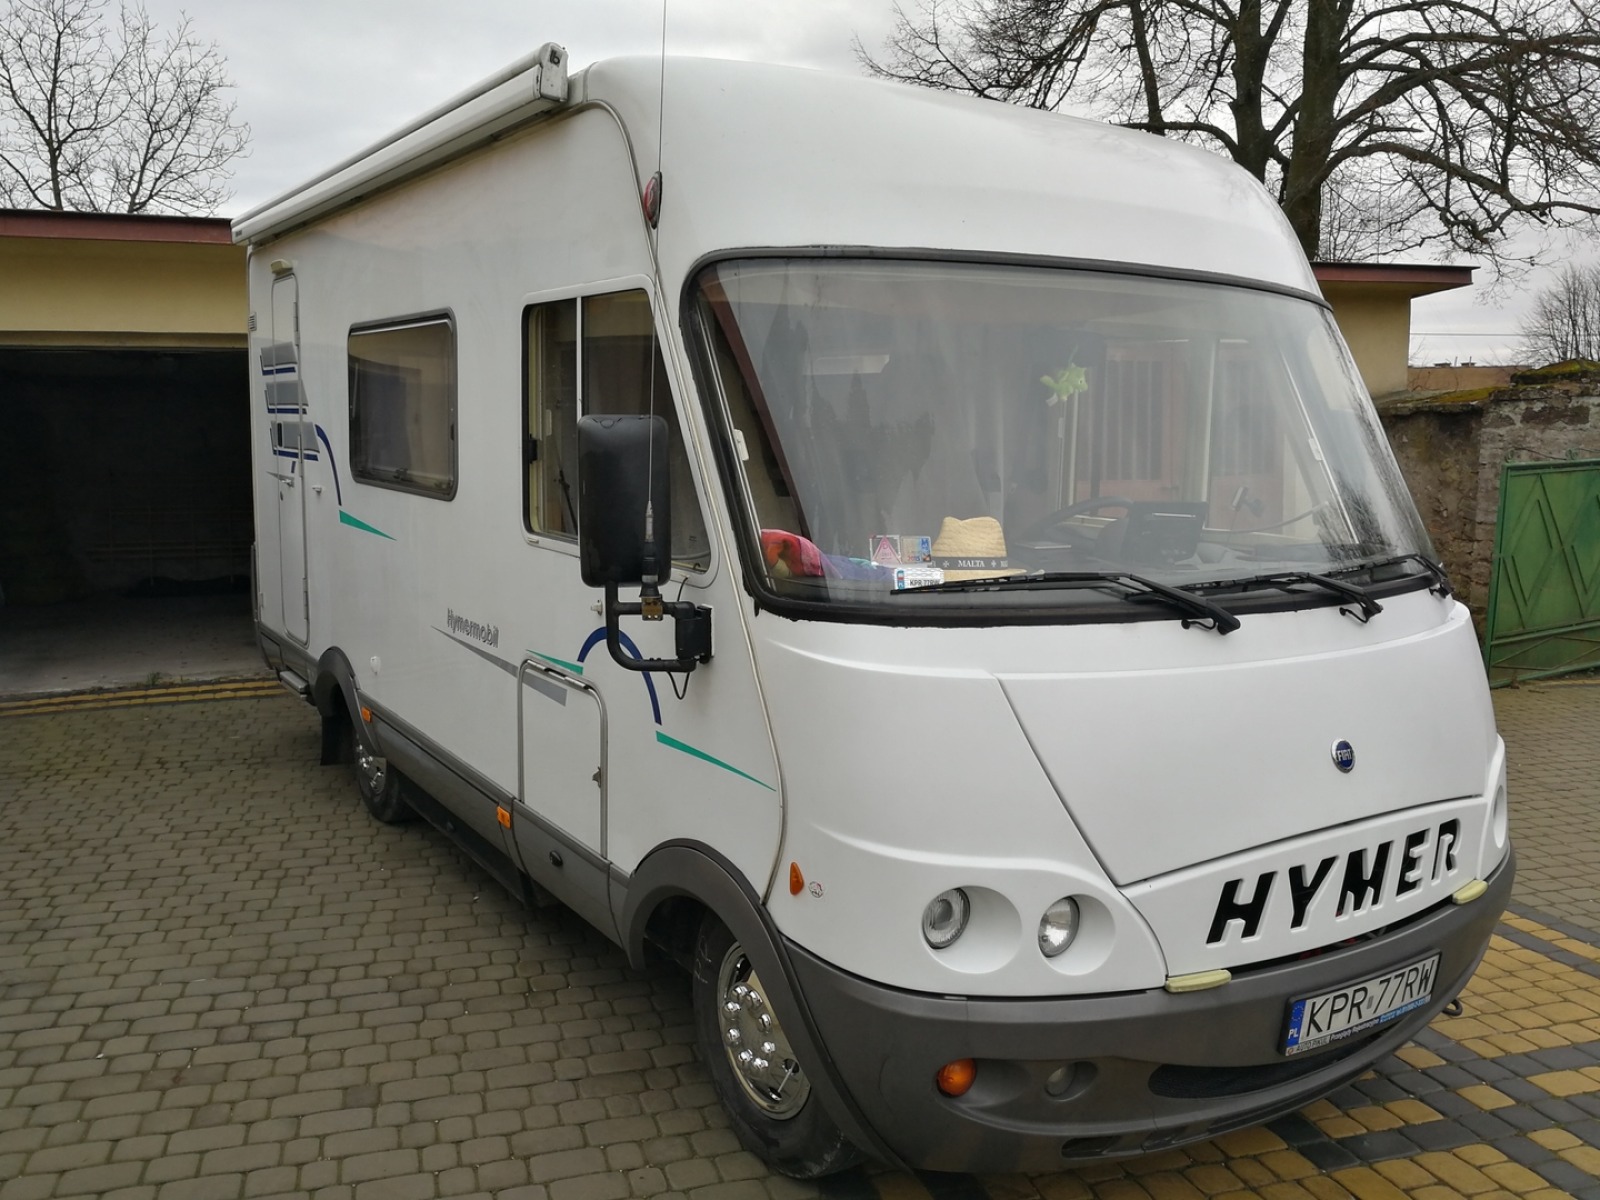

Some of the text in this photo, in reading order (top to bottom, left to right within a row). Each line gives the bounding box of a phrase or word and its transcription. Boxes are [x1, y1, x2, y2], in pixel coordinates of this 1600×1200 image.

[957, 560, 986, 568] MALTA
[909, 579, 922, 587] KPR
[447, 608, 499, 648] Hymermobil
[1206, 817, 1461, 946] HYMER
[1306, 986, 1369, 1037] KPR
[1373, 959, 1435, 1014] 77RW
[1287, 1028, 1299, 1039] PL
